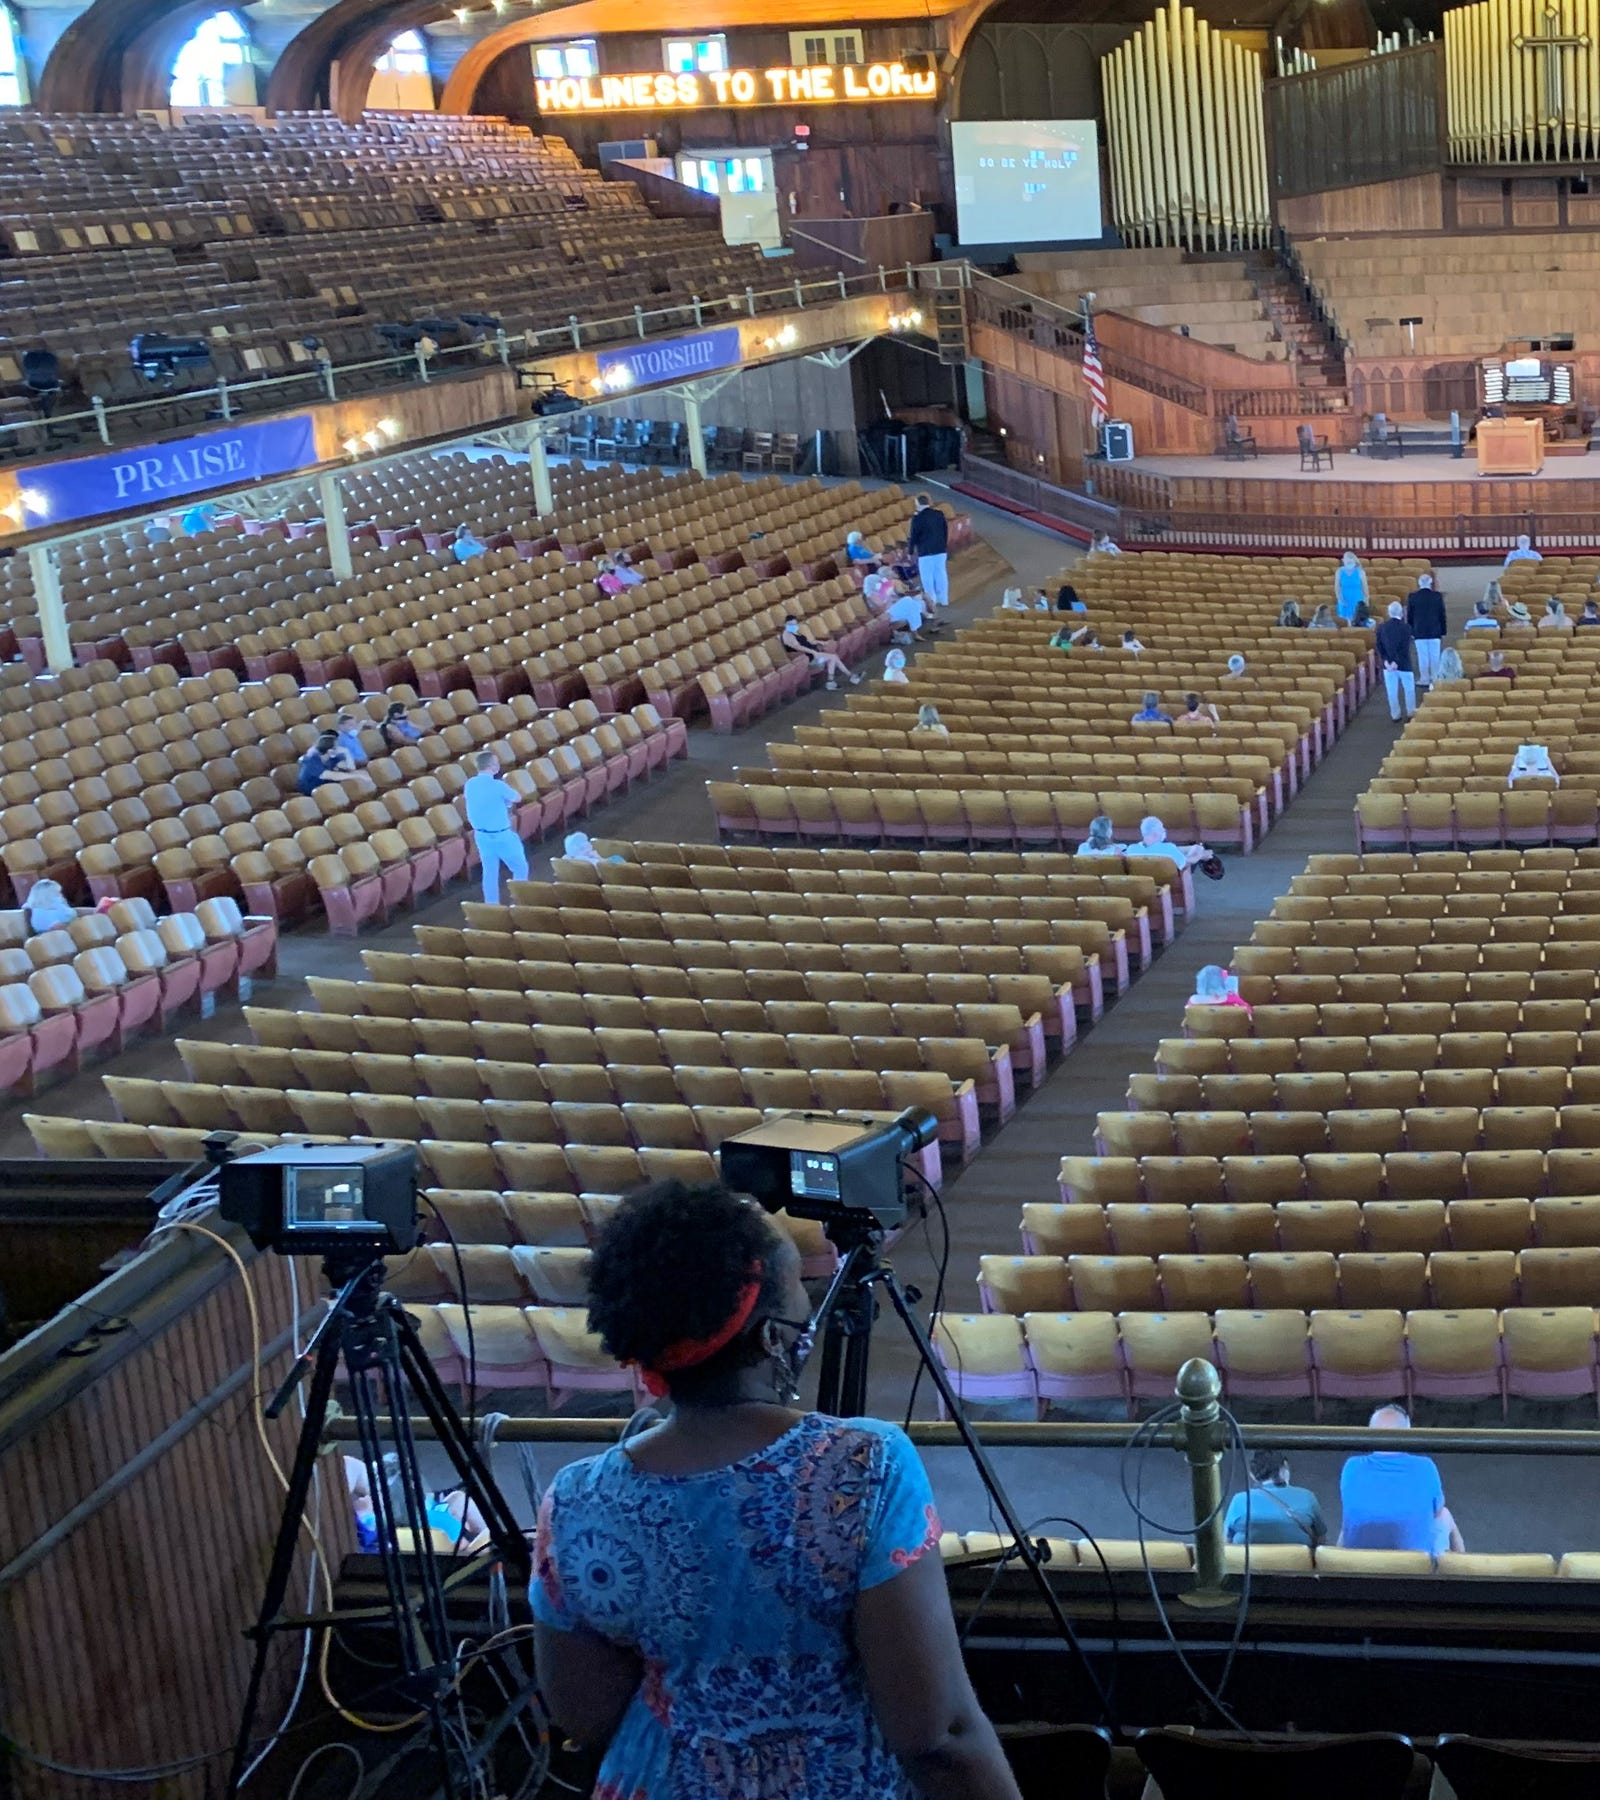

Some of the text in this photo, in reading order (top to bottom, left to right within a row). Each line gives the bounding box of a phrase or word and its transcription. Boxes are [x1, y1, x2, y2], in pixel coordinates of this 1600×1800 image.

[536, 74, 700, 110] HOLINESS
[710, 69, 757, 103] TO
[766, 66, 835, 100] THE
[630, 341, 714, 376] WORSHIP
[112, 440, 246, 498] PRAISE
